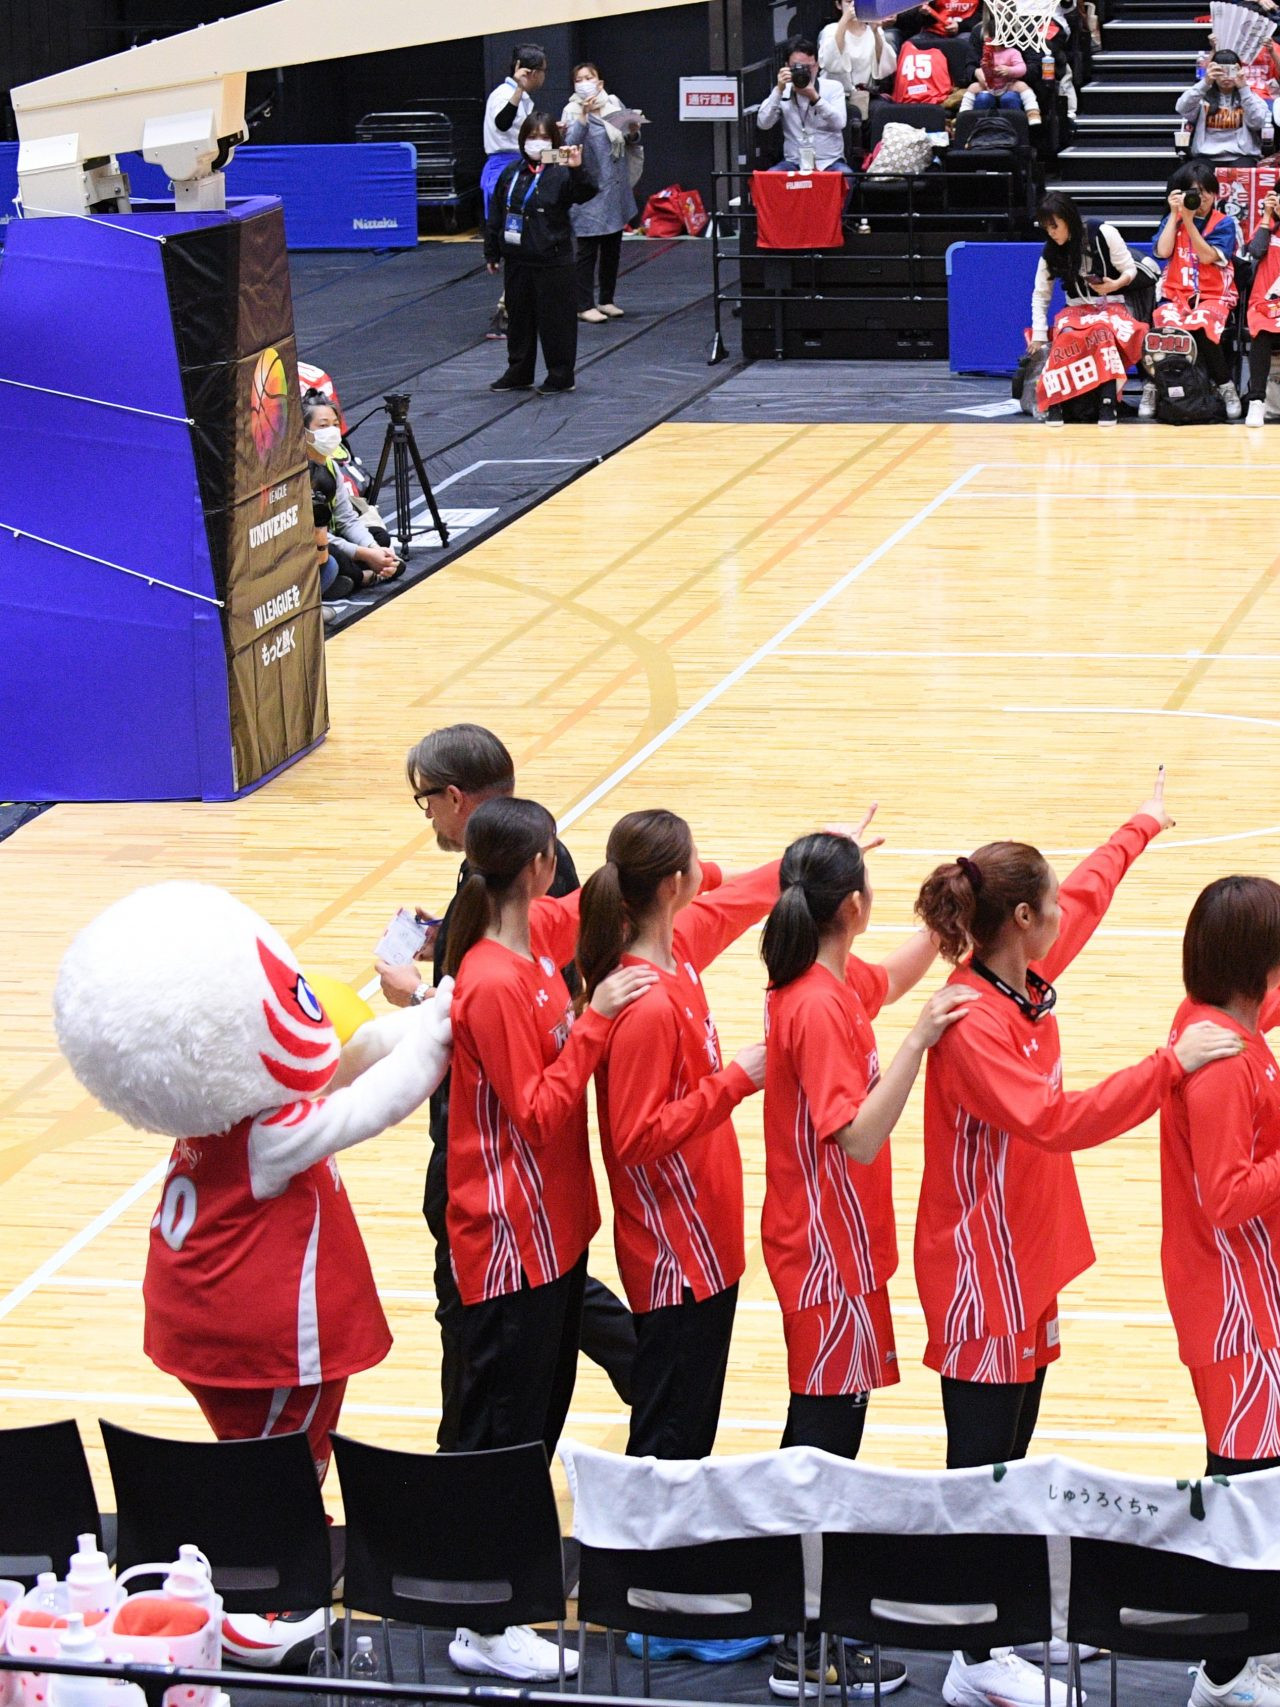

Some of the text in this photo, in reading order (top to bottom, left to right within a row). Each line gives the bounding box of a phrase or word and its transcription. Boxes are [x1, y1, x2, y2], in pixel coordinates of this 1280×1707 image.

[902, 54, 932, 80] 45
[688, 93, 733, 106] 通行禁止
[353, 217, 398, 230] Nittaku
[1042, 355, 1099, 399] 町田
[249, 504, 299, 549] UNIVERSE
[1048, 1483, 1160, 1517] じゅうろくちゃ
